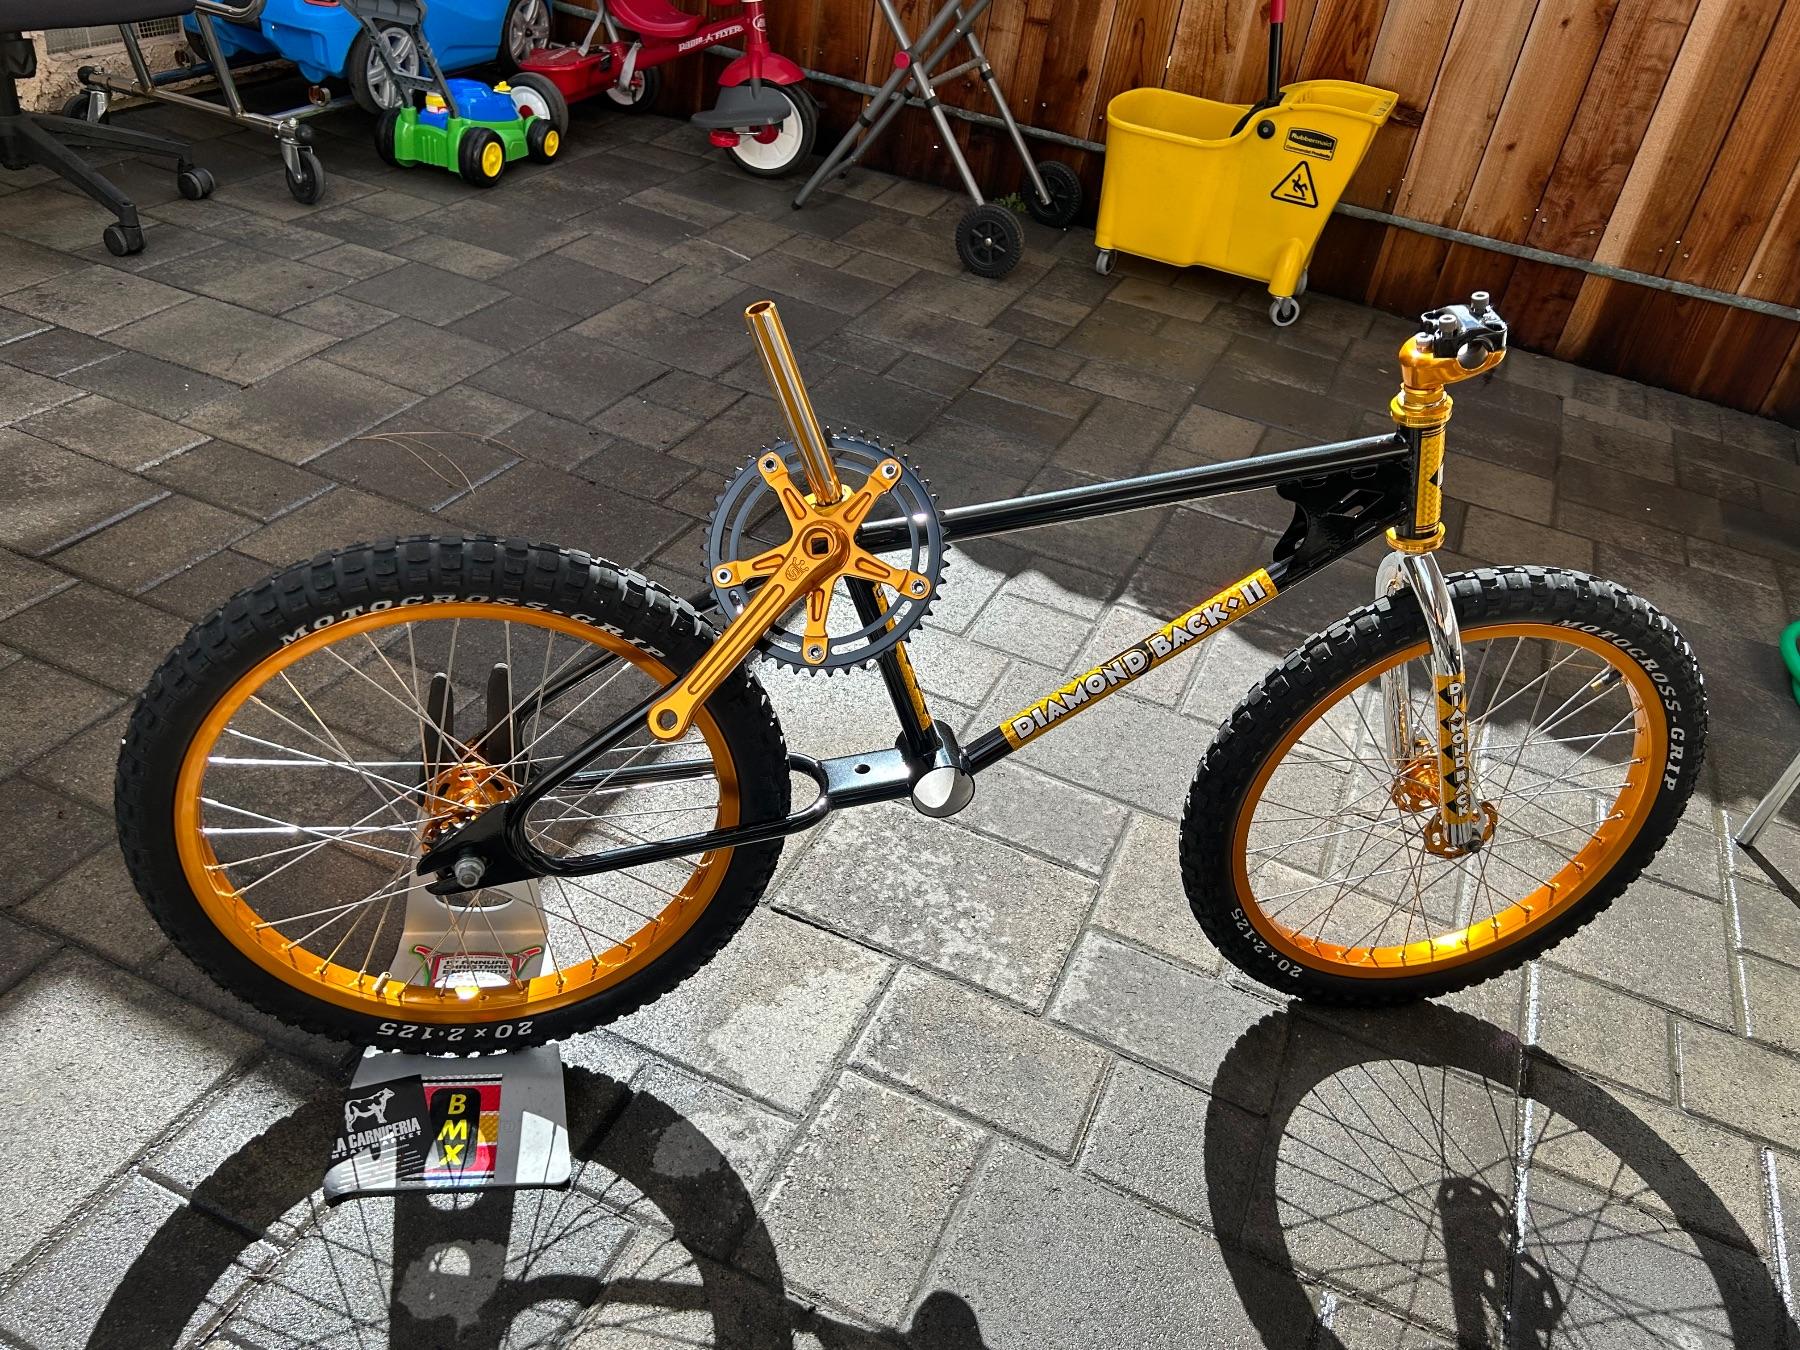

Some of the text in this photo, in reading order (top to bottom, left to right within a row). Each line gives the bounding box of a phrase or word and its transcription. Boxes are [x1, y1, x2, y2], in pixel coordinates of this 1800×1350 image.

[715, 25, 744, 39] FLYER
[1291, 132, 1332, 147] Rubbermaid
[1011, 649, 1148, 740] DIAMOND
[1150, 603, 1230, 658] BACK
[1276, 959, 1303, 978] 20
[495, 1021, 534, 1039] 20
[348, 1117, 422, 1149] CARNICERIA
[438, 1094, 468, 1166] BMX
[331, 1130, 422, 1159] MEAT MARKET
